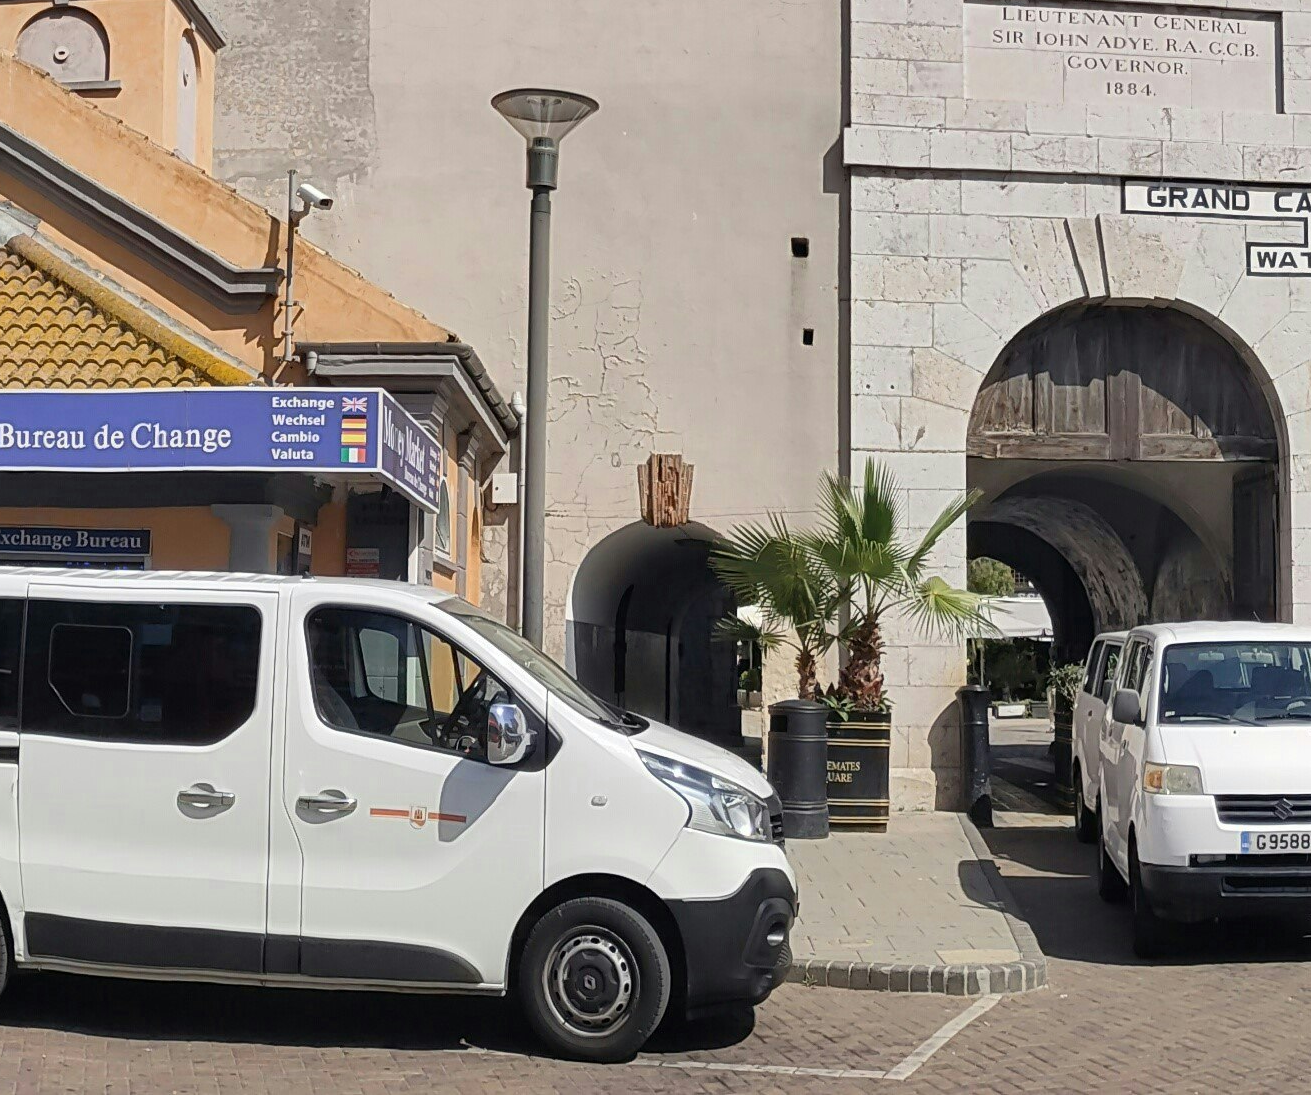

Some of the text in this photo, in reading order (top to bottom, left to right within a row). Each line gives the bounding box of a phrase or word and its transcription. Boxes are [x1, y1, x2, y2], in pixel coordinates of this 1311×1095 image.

[1002, 6, 1247, 35] LIEUTENANT GENERAL
[992, 29, 1024, 44] SIR
[1146, 186, 1250, 212] GRAND
[271, 396, 335, 411] Exchange
[272, 414, 326, 427] Wechsel
[93, 423, 125, 450] de
[130, 422, 232, 453] Change
[271, 431, 320, 443] Cambio
[271, 448, 314, 460] Valuta
[76, 530, 142, 548] Bureau
[826, 761, 861, 771] EMATES
[826, 773, 853, 783] UARE
